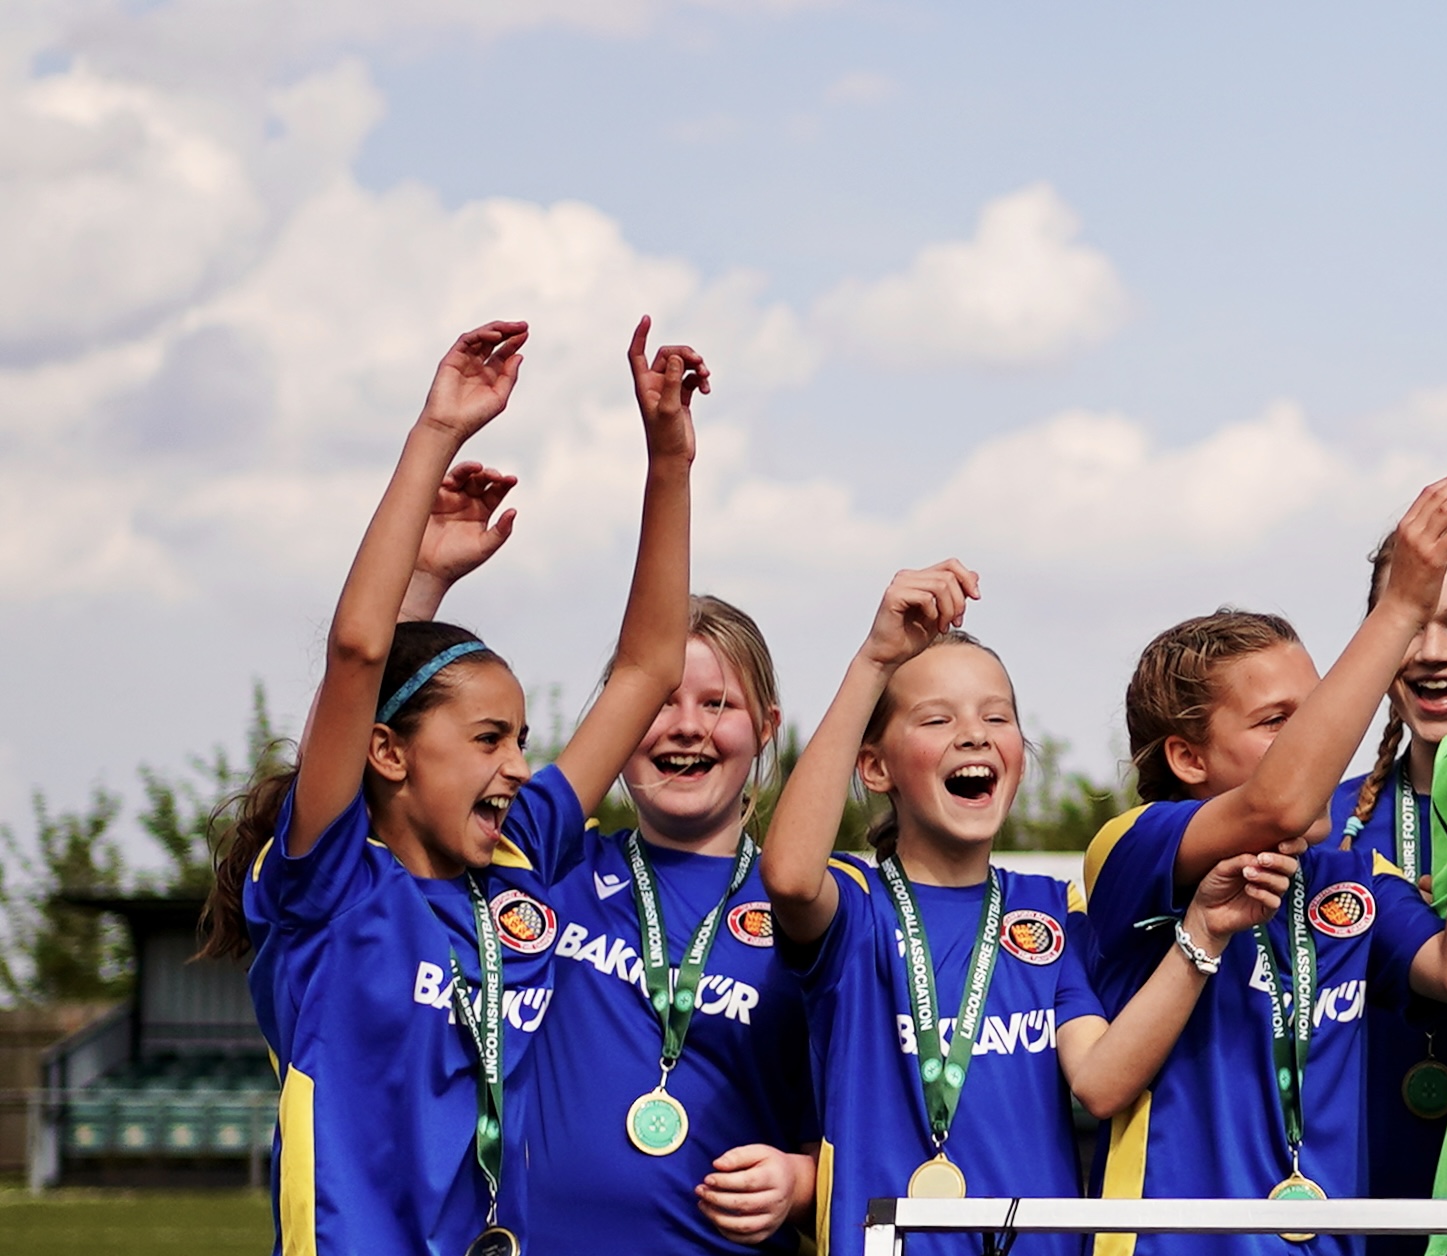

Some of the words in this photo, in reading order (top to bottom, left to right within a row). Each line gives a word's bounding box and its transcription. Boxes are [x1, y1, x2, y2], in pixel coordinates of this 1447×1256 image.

[477, 897, 498, 972] FOOTBALL
[889, 878, 920, 937] FOOTBALL
[909, 937, 934, 1031] ASSOCIATION
[1292, 882, 1308, 946] FOOTBALL
[485, 972, 499, 1084] LINCOLNSHIRE
[960, 942, 994, 1039] LINCOLNSHIRE
[1295, 946, 1311, 1041] ASSOCIATION
